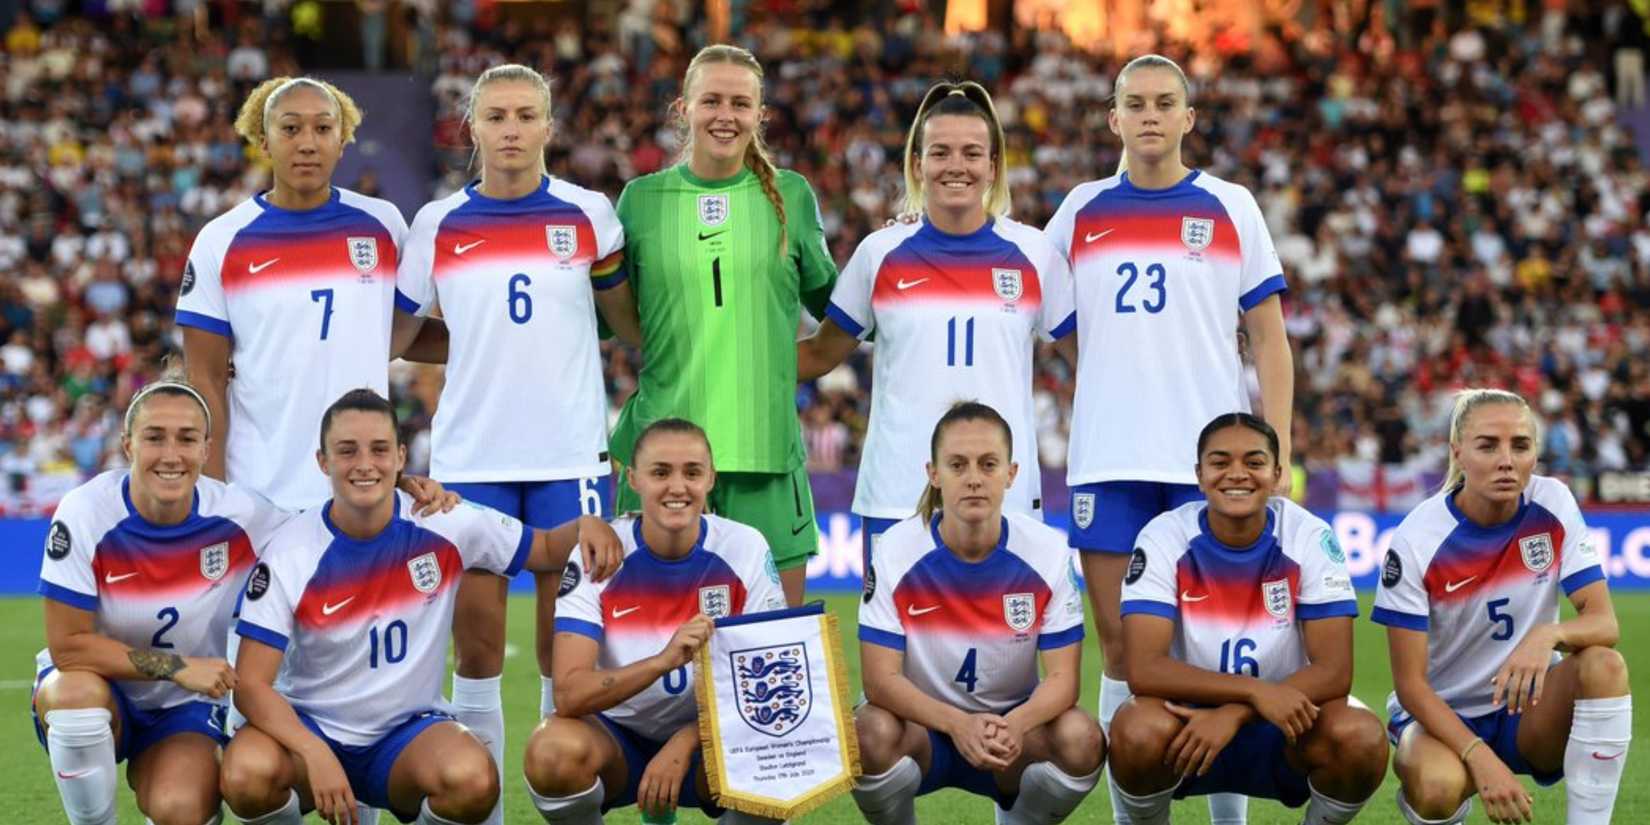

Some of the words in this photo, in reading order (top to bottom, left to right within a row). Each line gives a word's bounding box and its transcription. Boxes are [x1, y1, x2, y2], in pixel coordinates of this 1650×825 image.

[507, 273, 533, 325] 6
[713, 256, 723, 307] 1
[1116, 261, 1166, 314] 23
[311, 288, 334, 341] 7
[947, 316, 974, 367] 11
[578, 477, 602, 517] 6
[151, 606, 180, 649] 2
[369, 619, 408, 669] 10
[1487, 597, 1514, 641] 5
[955, 648, 978, 693] 4
[1220, 638, 1259, 678] 16
